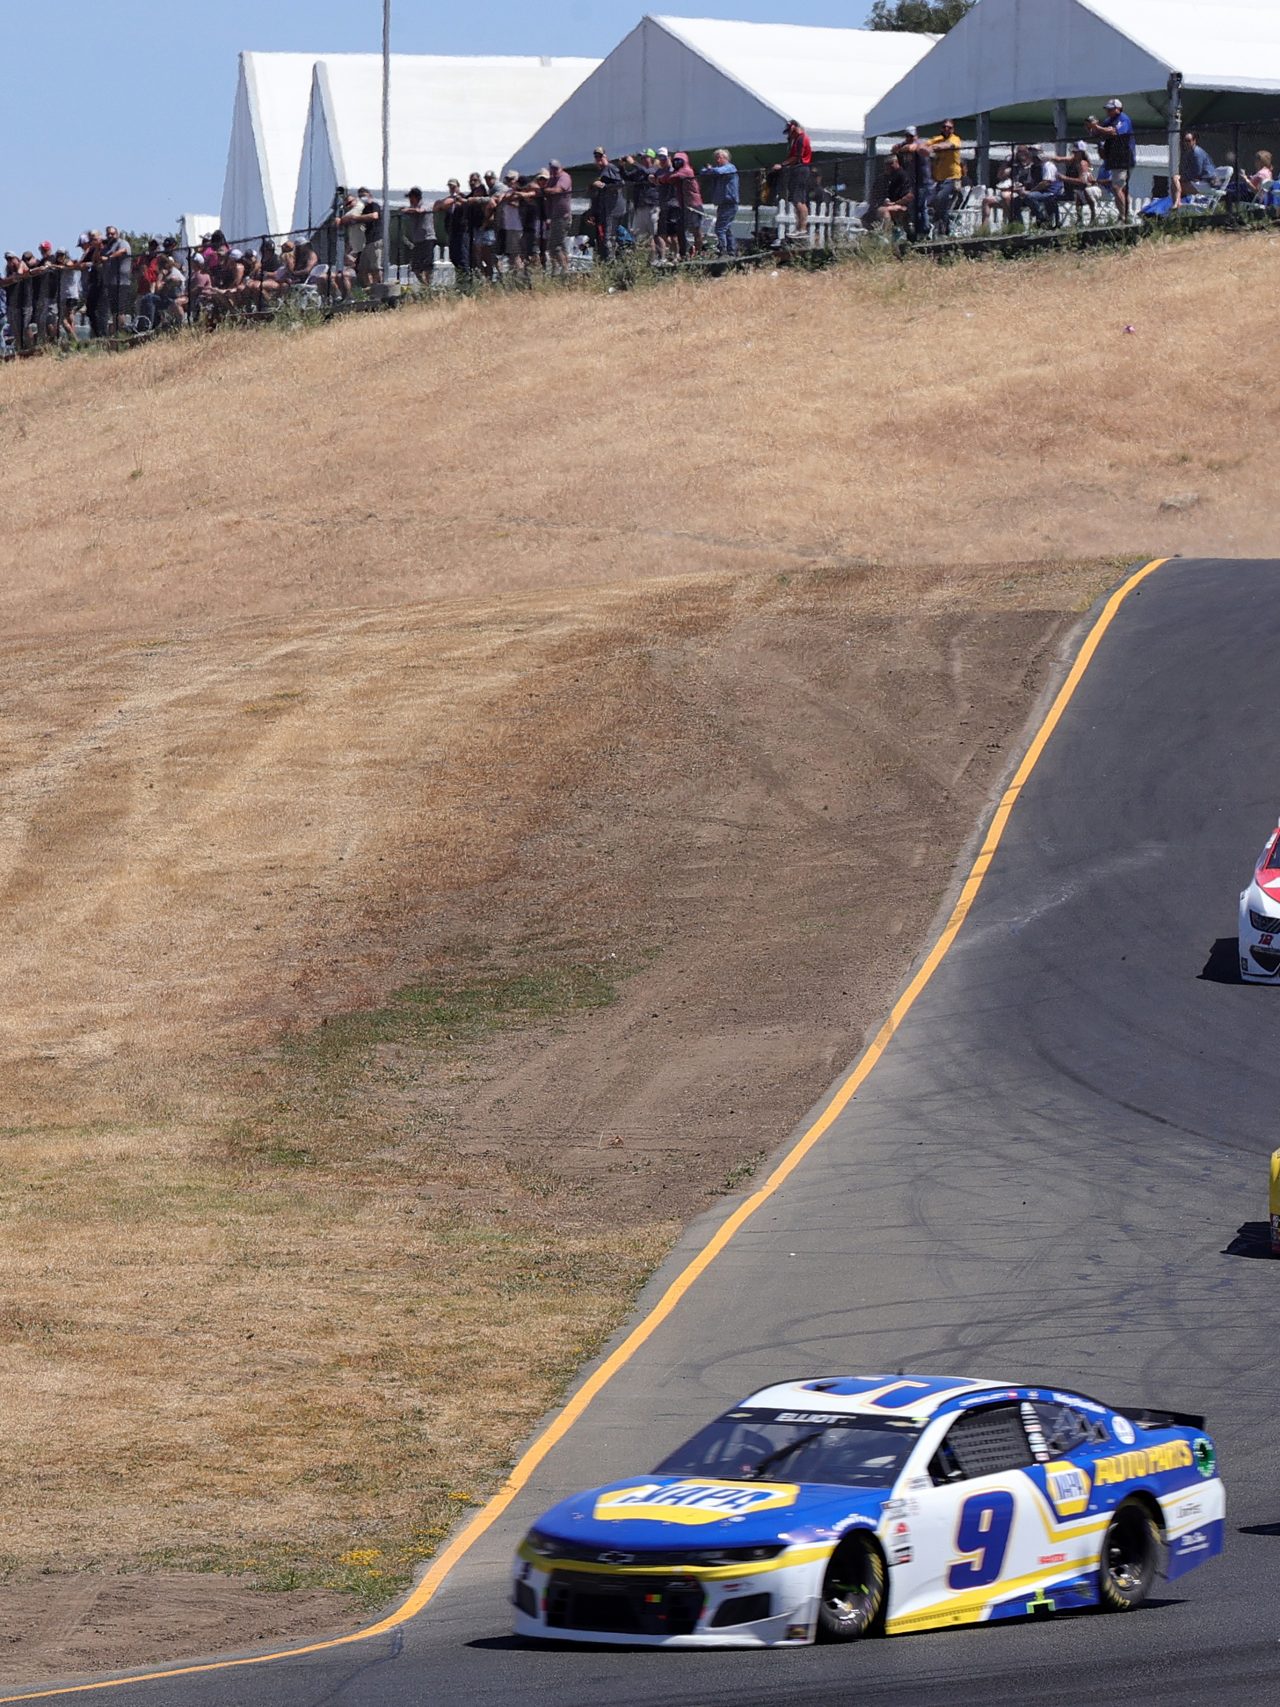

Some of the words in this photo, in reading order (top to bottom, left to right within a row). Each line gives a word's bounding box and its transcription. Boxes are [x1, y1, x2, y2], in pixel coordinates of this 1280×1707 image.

[1258, 933, 1274, 946] 12
[616, 1485, 774, 1510] NAPA
[946, 1487, 1017, 1592] 9
